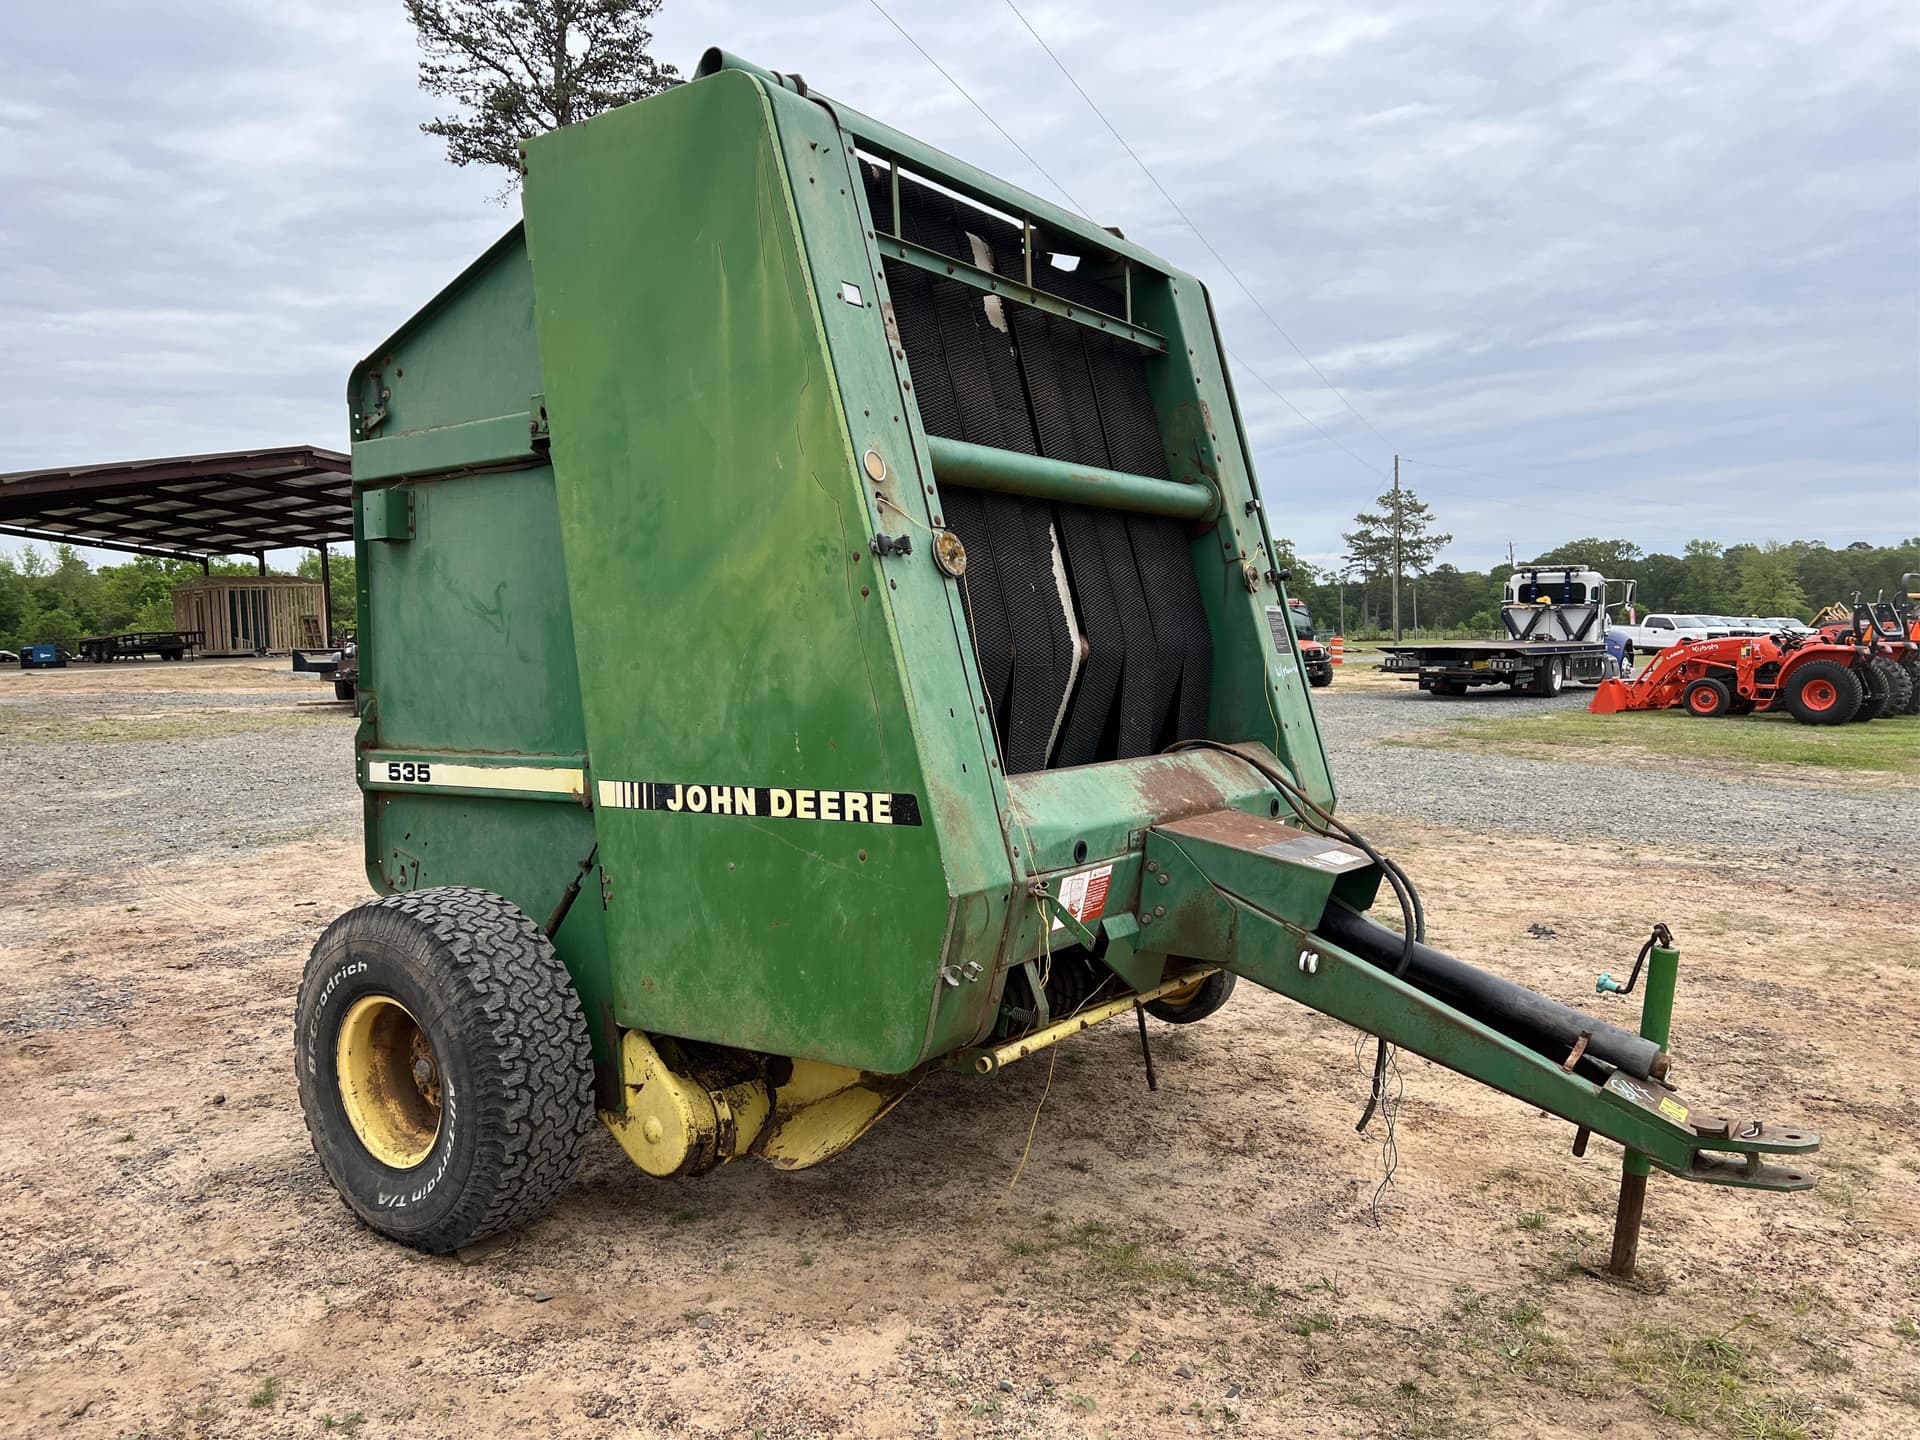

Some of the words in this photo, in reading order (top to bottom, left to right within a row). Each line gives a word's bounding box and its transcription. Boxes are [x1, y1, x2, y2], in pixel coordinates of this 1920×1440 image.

[1692, 643, 1719, 653] Kubota
[388, 763, 431, 782] 535
[667, 784, 756, 816] JOHN
[769, 788, 894, 825] DEERE
[411, 1076, 457, 1202] All-Terrain
[378, 1191, 407, 1207] T/A
